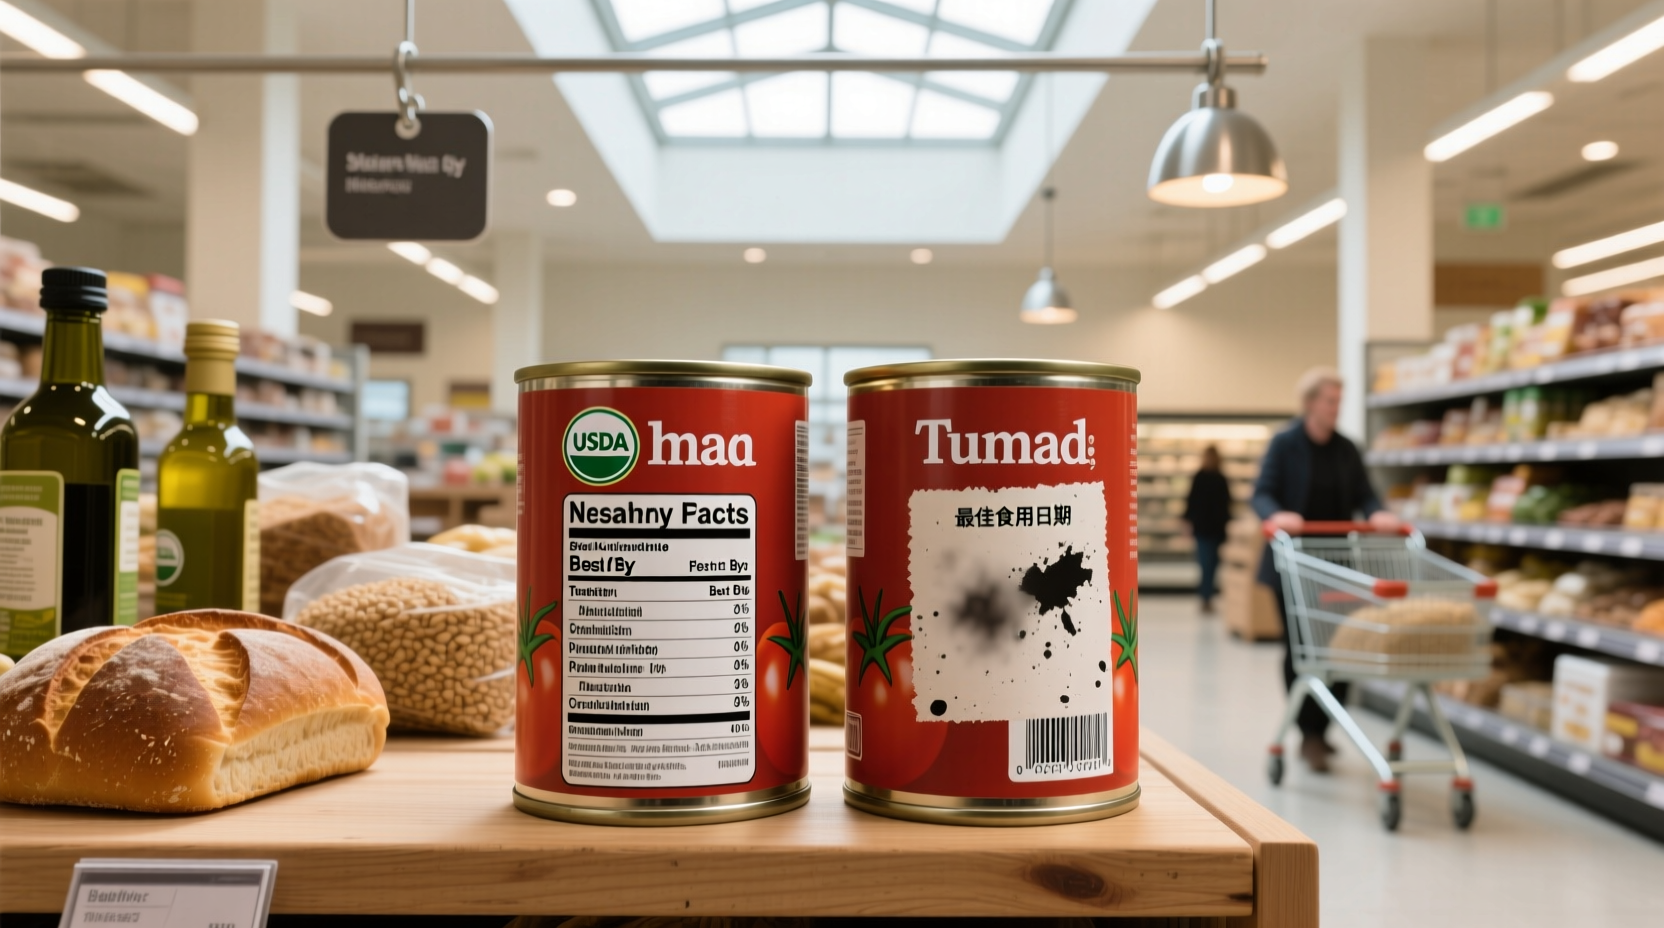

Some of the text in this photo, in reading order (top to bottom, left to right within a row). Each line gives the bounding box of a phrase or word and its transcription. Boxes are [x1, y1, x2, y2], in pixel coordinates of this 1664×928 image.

[573, 432, 629, 452] USDA
[954, 504, 1072, 528] 最佳食用日期
